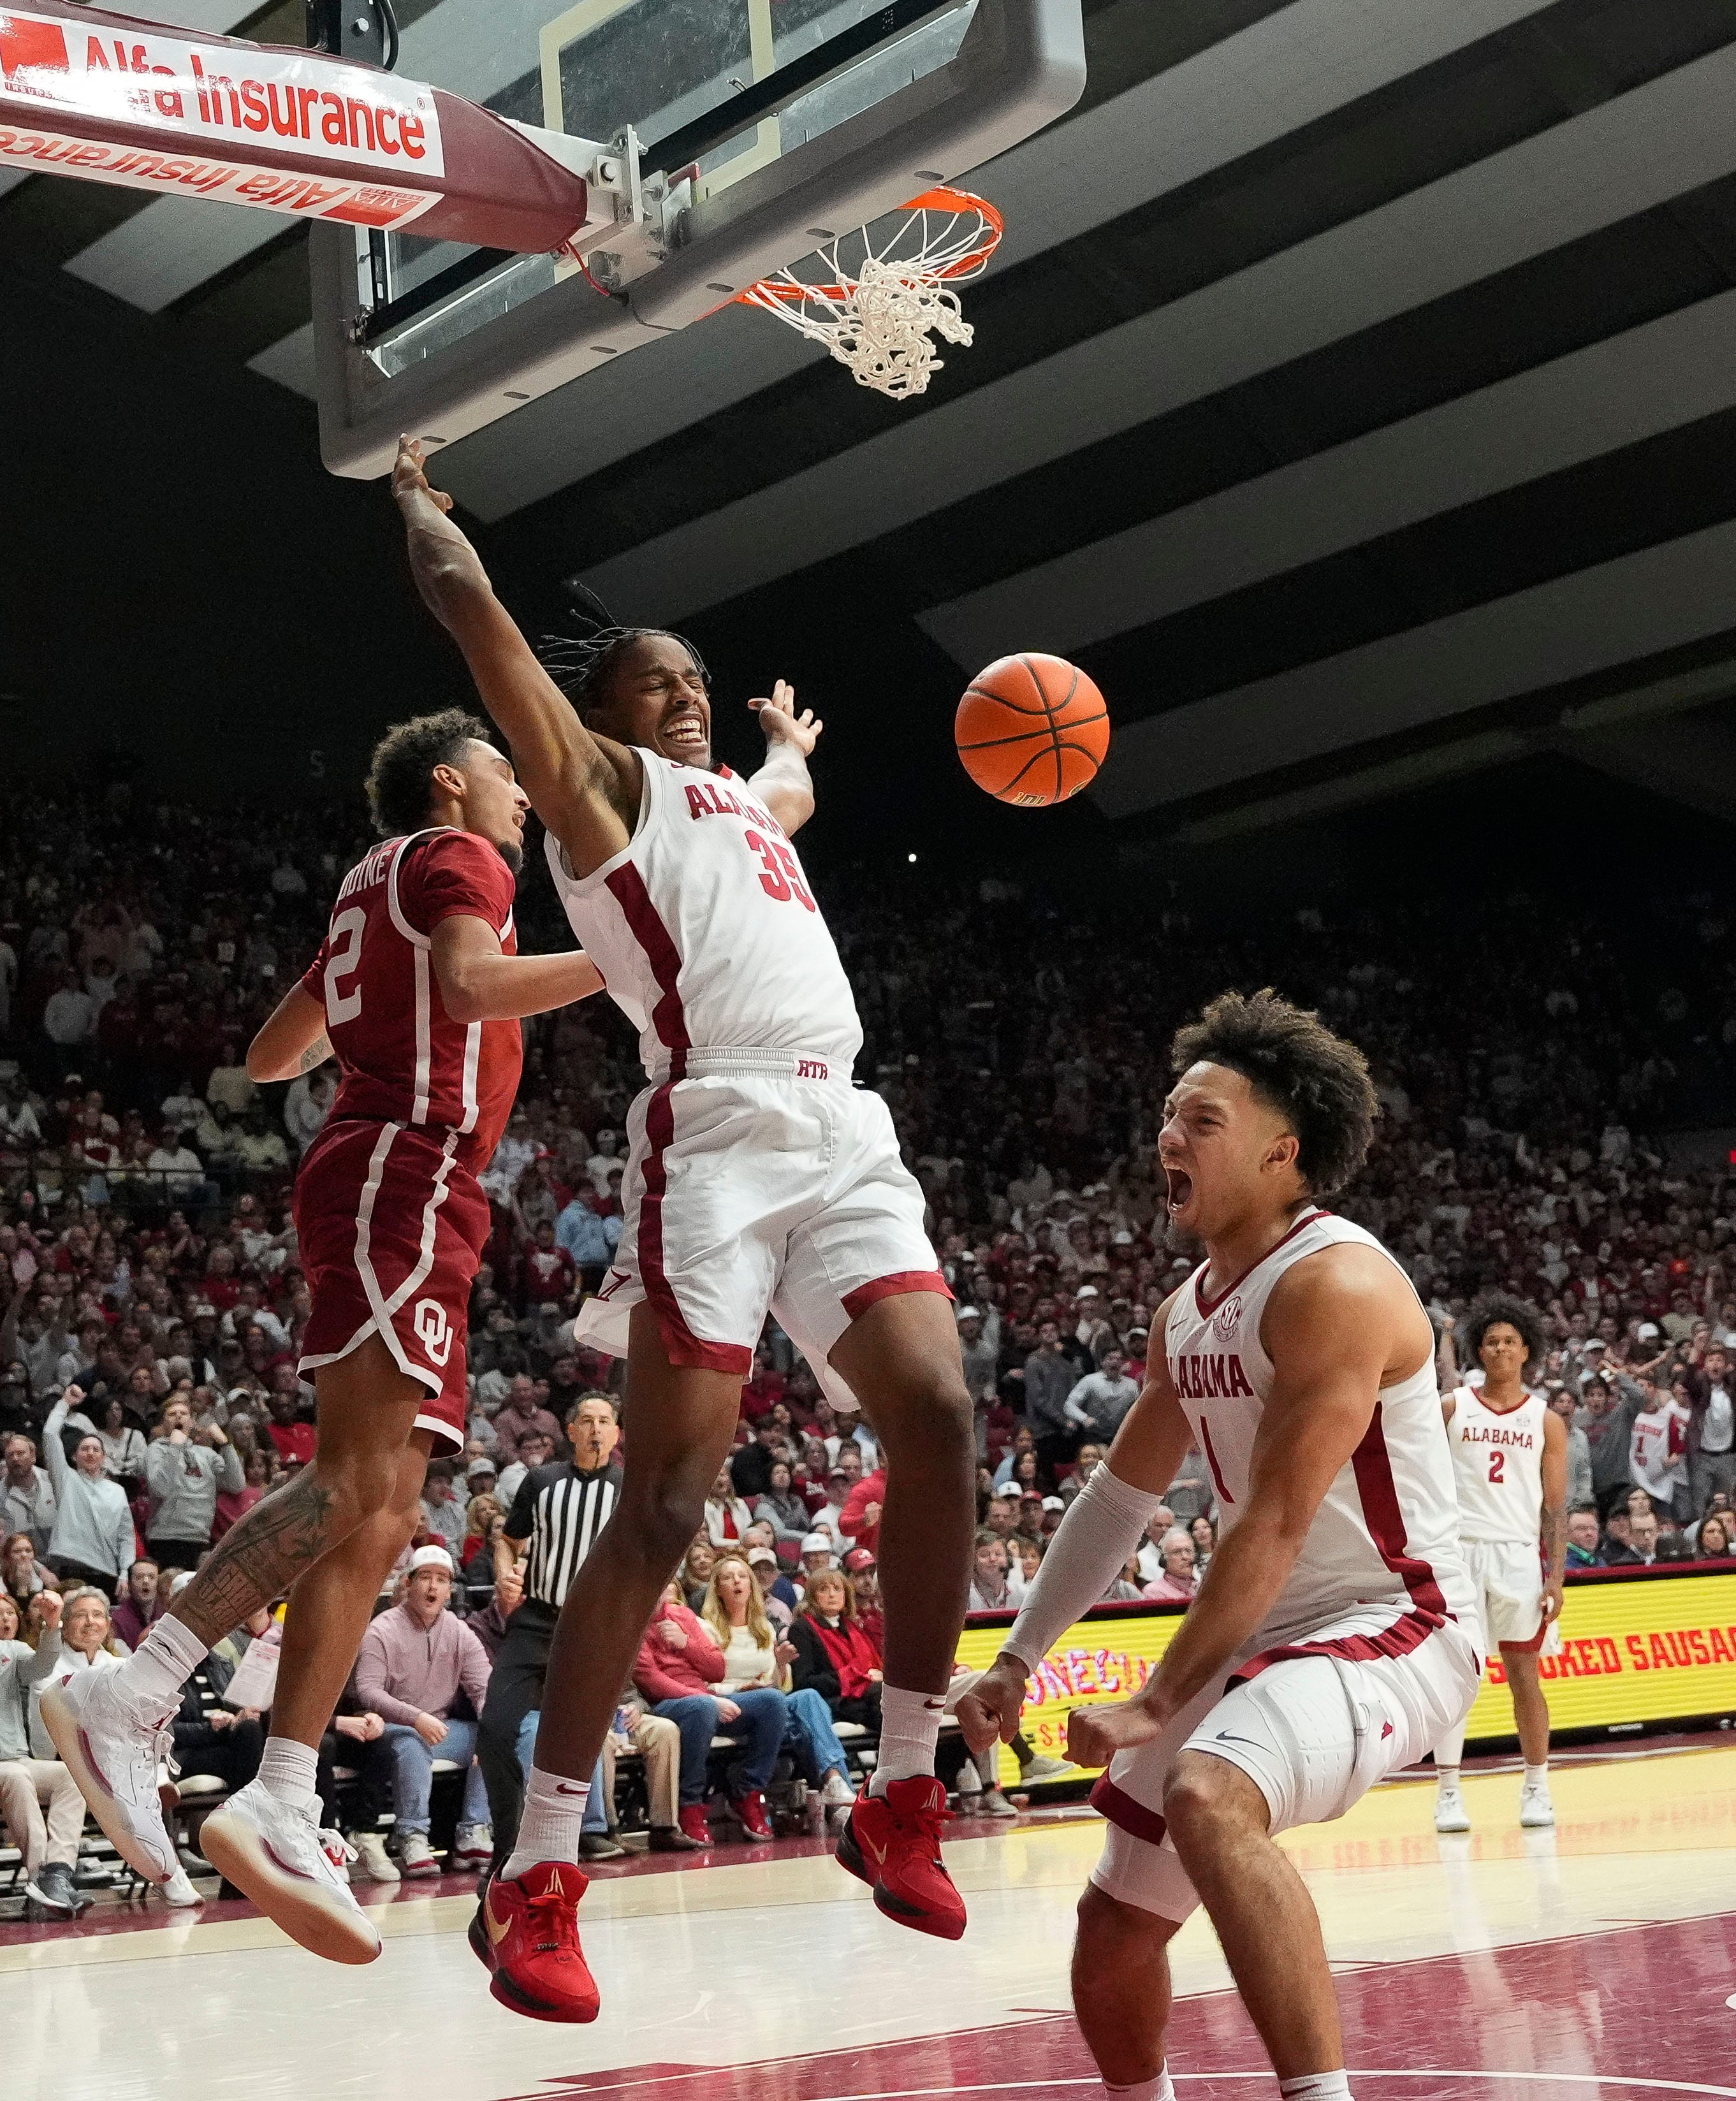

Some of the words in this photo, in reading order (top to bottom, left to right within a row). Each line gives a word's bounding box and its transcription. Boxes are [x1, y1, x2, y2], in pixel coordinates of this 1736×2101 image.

[235, 173, 351, 209] Alfa
[354, 192, 411, 209] ALFA
[745, 829, 815, 913] 35
[324, 906, 366, 1028] 2
[797, 1059, 828, 1080] RTR
[413, 1298, 454, 1367] OU
[1461, 1427, 1533, 1450] ALABAMA
[1489, 1451, 1505, 1484] 2
[1485, 1637, 1623, 1685] SOKED
